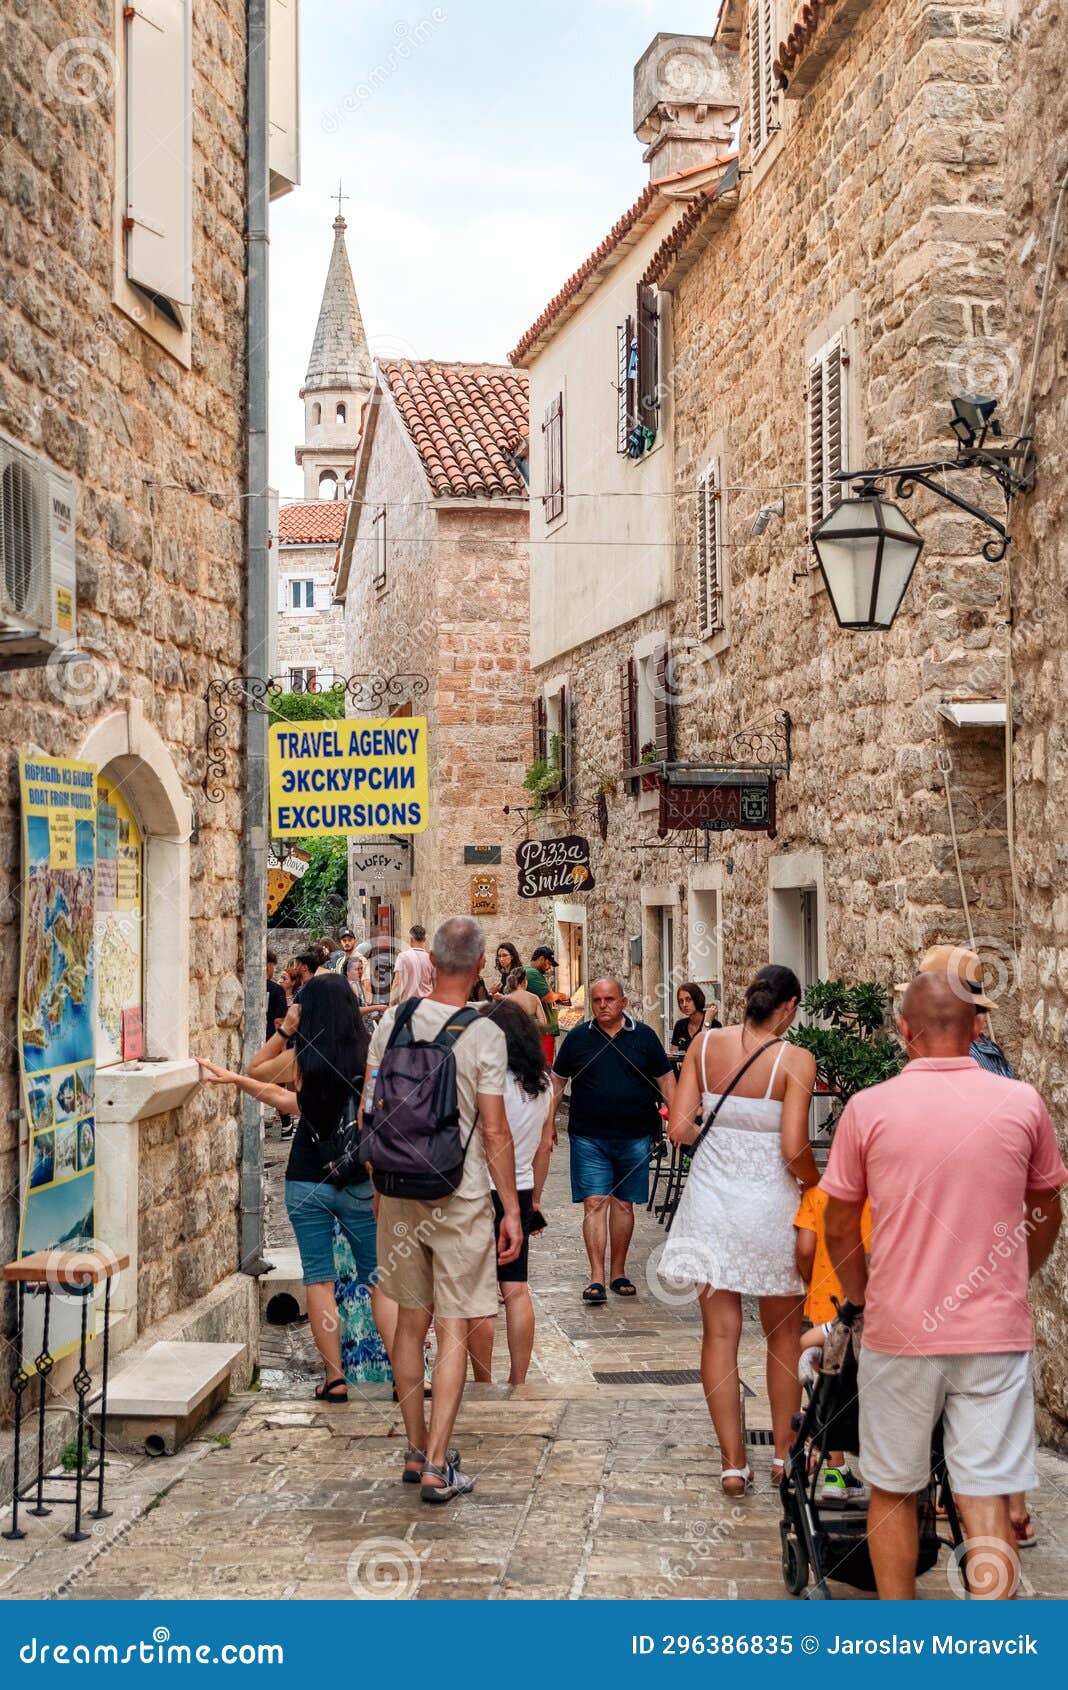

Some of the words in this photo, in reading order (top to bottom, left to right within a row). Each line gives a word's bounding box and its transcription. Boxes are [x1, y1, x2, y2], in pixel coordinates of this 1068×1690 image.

[277, 731, 343, 759] TRAVEL
[348, 728, 419, 756] AGENCY
[281, 766, 415, 793] ЭКСКУРСИИ
[29, 788, 49, 807] BOAT
[668, 788, 738, 803] STARA
[277, 802, 421, 829] EXCURSIONS
[668, 803, 737, 818] BUDVA
[521, 840, 588, 870] Pizza
